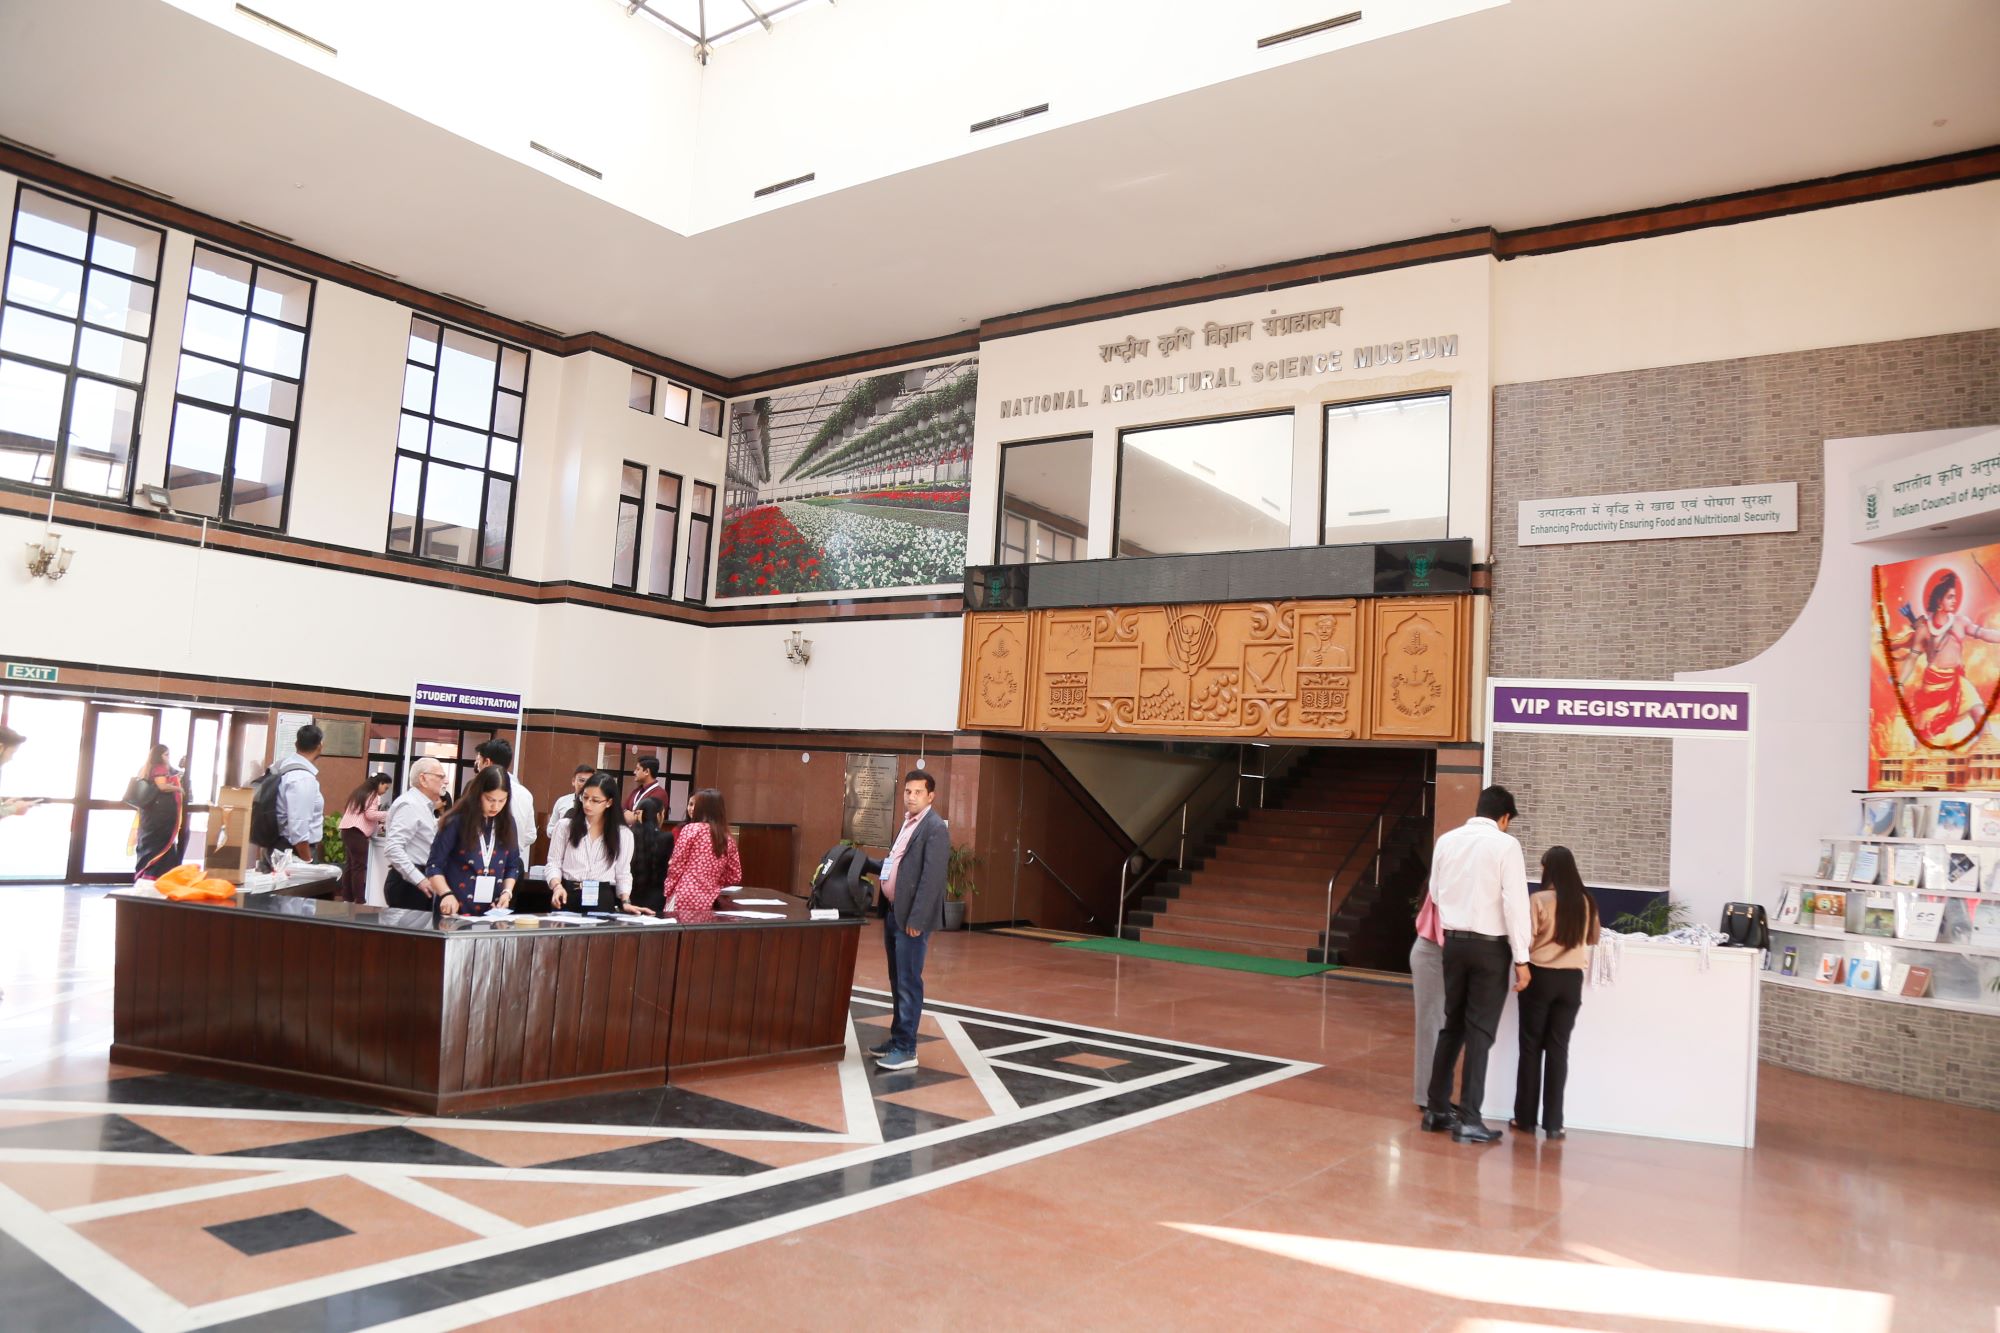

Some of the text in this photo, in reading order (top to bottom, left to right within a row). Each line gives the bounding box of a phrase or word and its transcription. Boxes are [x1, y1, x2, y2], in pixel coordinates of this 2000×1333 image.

[1099, 308, 1343, 363] राष्ट्रीय कृषि विज्ञान संग्रहालय
[1000, 334, 1459, 419] NATIONAL AGRICULTURAL SCIENCE MUSEUM
[1937, 464, 1963, 486] कृषि
[1537, 495, 1772, 518] उत्पादकता में वृद्धि से खाद्य एवं पोषण सुरक्षा
[1893, 503, 1920, 518] Indian
[1921, 492, 1957, 511] Council
[1958, 489, 1968, 502] of
[1530, 524, 1569, 535] Enhancing
[1570, 519, 1618, 532] Productivity
[1619, 518, 1654, 529] Ensuring
[1655, 517, 1676, 527] Food
[1677, 515, 1692, 525] and
[1744, 510, 1781, 522] Security
[12, 666, 52, 680] EXIT
[416, 690, 518, 709] STUDENT REGISTRATION
[1510, 698, 1738, 721] VIP REGISTRATION
